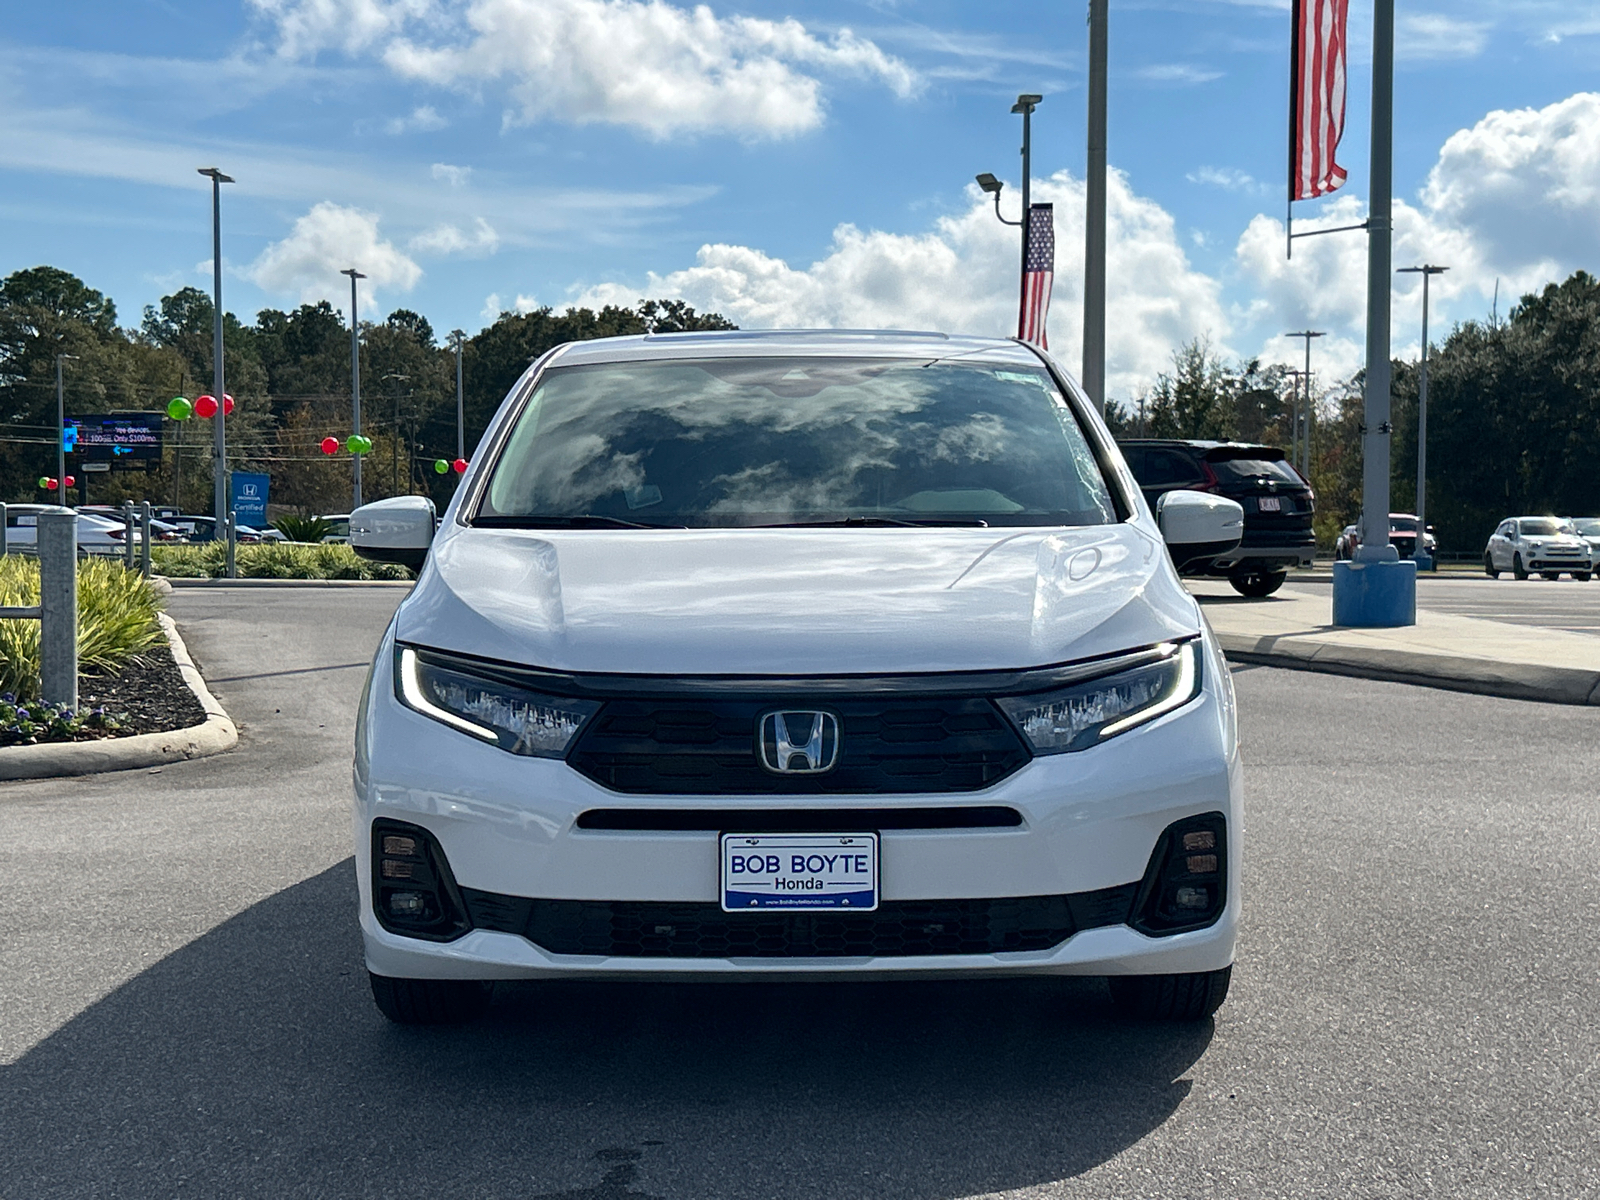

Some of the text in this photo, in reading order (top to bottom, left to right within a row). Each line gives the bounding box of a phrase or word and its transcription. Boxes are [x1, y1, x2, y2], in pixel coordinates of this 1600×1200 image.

[234, 503, 264, 511] Certified
[731, 854, 869, 873] BOB BOYTE
[774, 877, 824, 890] Honda
